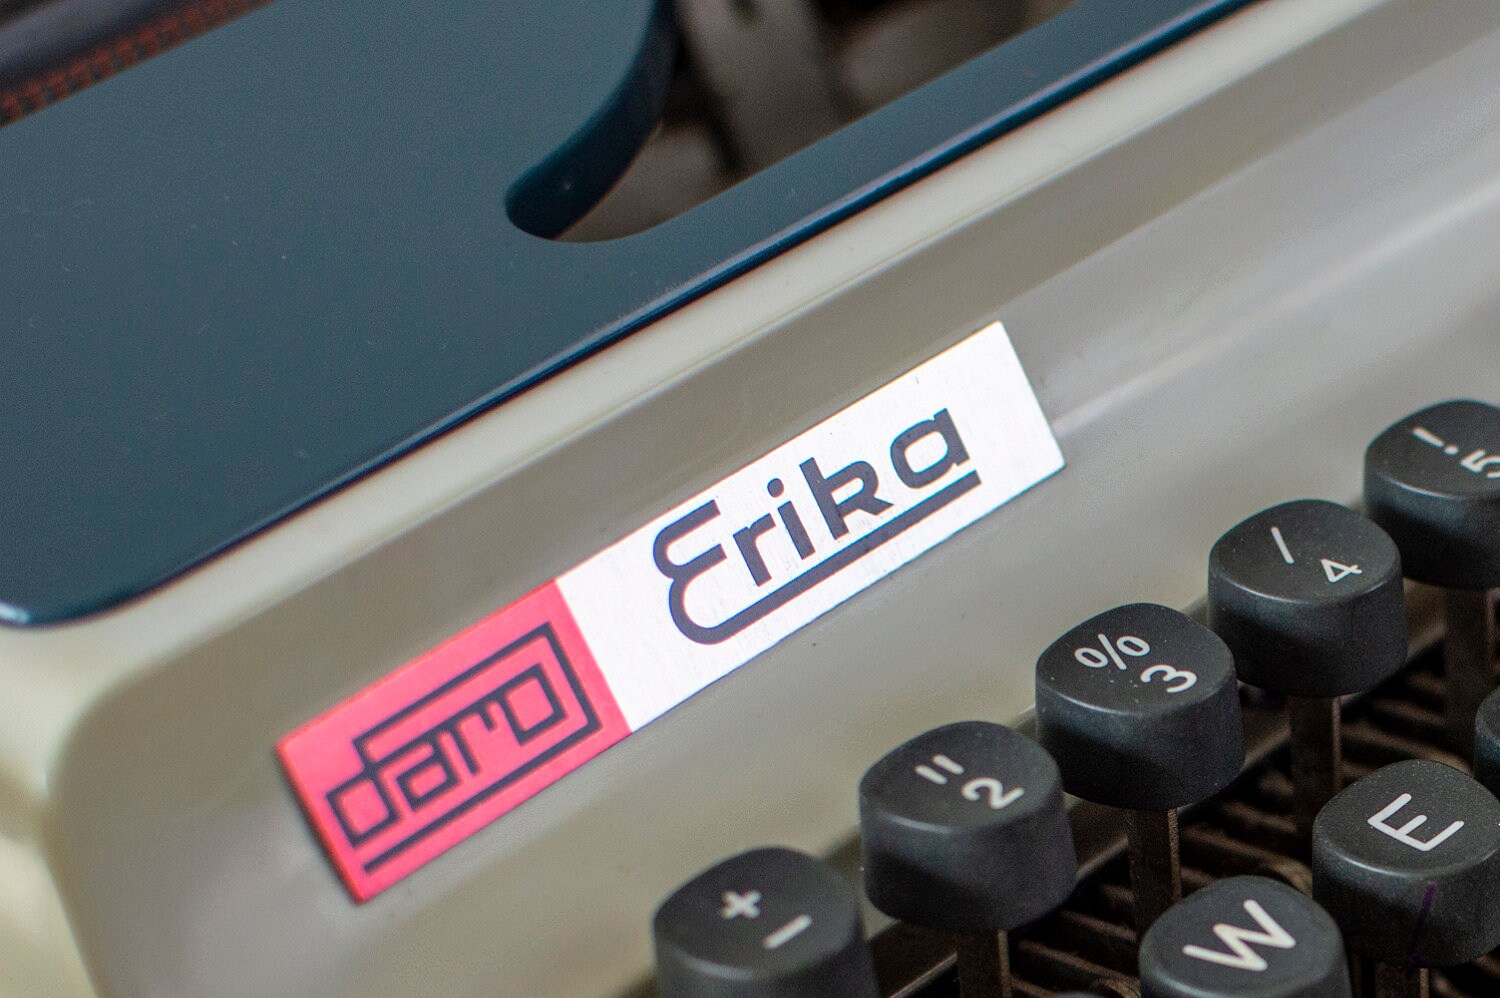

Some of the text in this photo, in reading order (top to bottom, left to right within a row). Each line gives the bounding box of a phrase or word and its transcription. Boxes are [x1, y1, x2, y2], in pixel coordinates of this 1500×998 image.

[1411, 426, 1461, 457] !
[652, 408, 982, 646] Erika
[1319, 557, 1364, 584] 4
[1073, 632, 1152, 672] %
[1139, 663, 1199, 695] 3
[326, 622, 602, 850] daro
[961, 776, 1025, 810] 2
[1366, 792, 1466, 853] E
[722, 890, 762, 919] +
[1182, 898, 1297, 972] W
